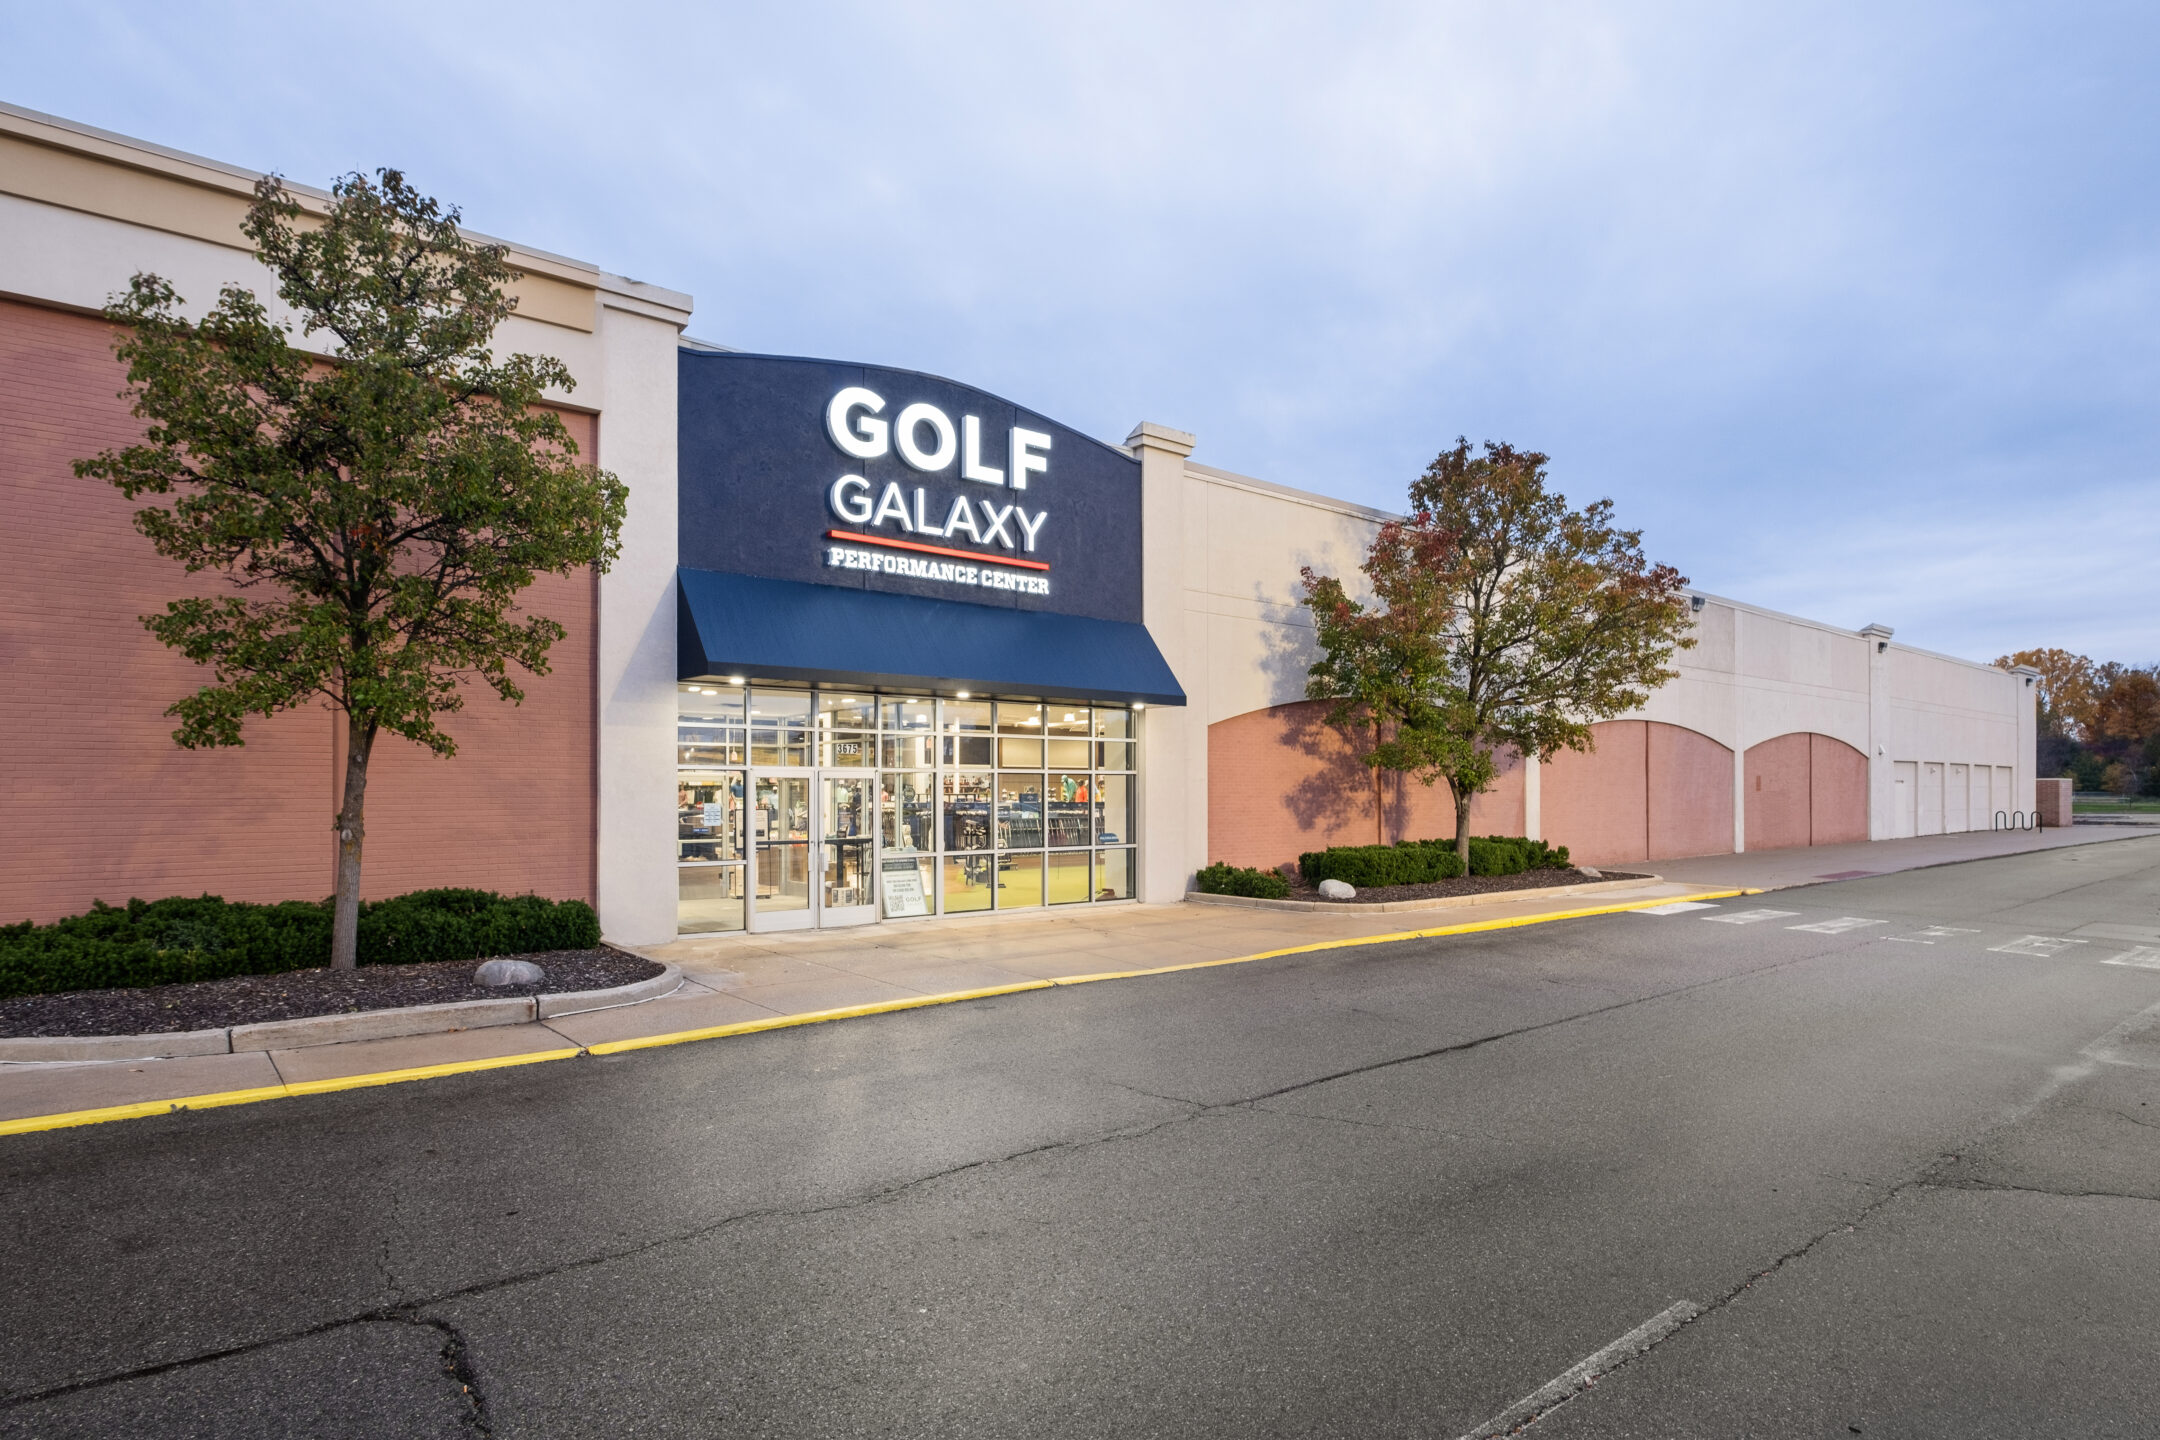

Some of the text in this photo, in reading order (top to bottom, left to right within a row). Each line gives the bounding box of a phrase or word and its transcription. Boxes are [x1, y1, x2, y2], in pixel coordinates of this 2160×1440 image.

[826, 386, 1051, 490] GOLF
[830, 474, 1048, 553] GALAXY
[828, 547, 1050, 595] PERFORMANCE CENTER
[837, 744, 858, 754] 3675
